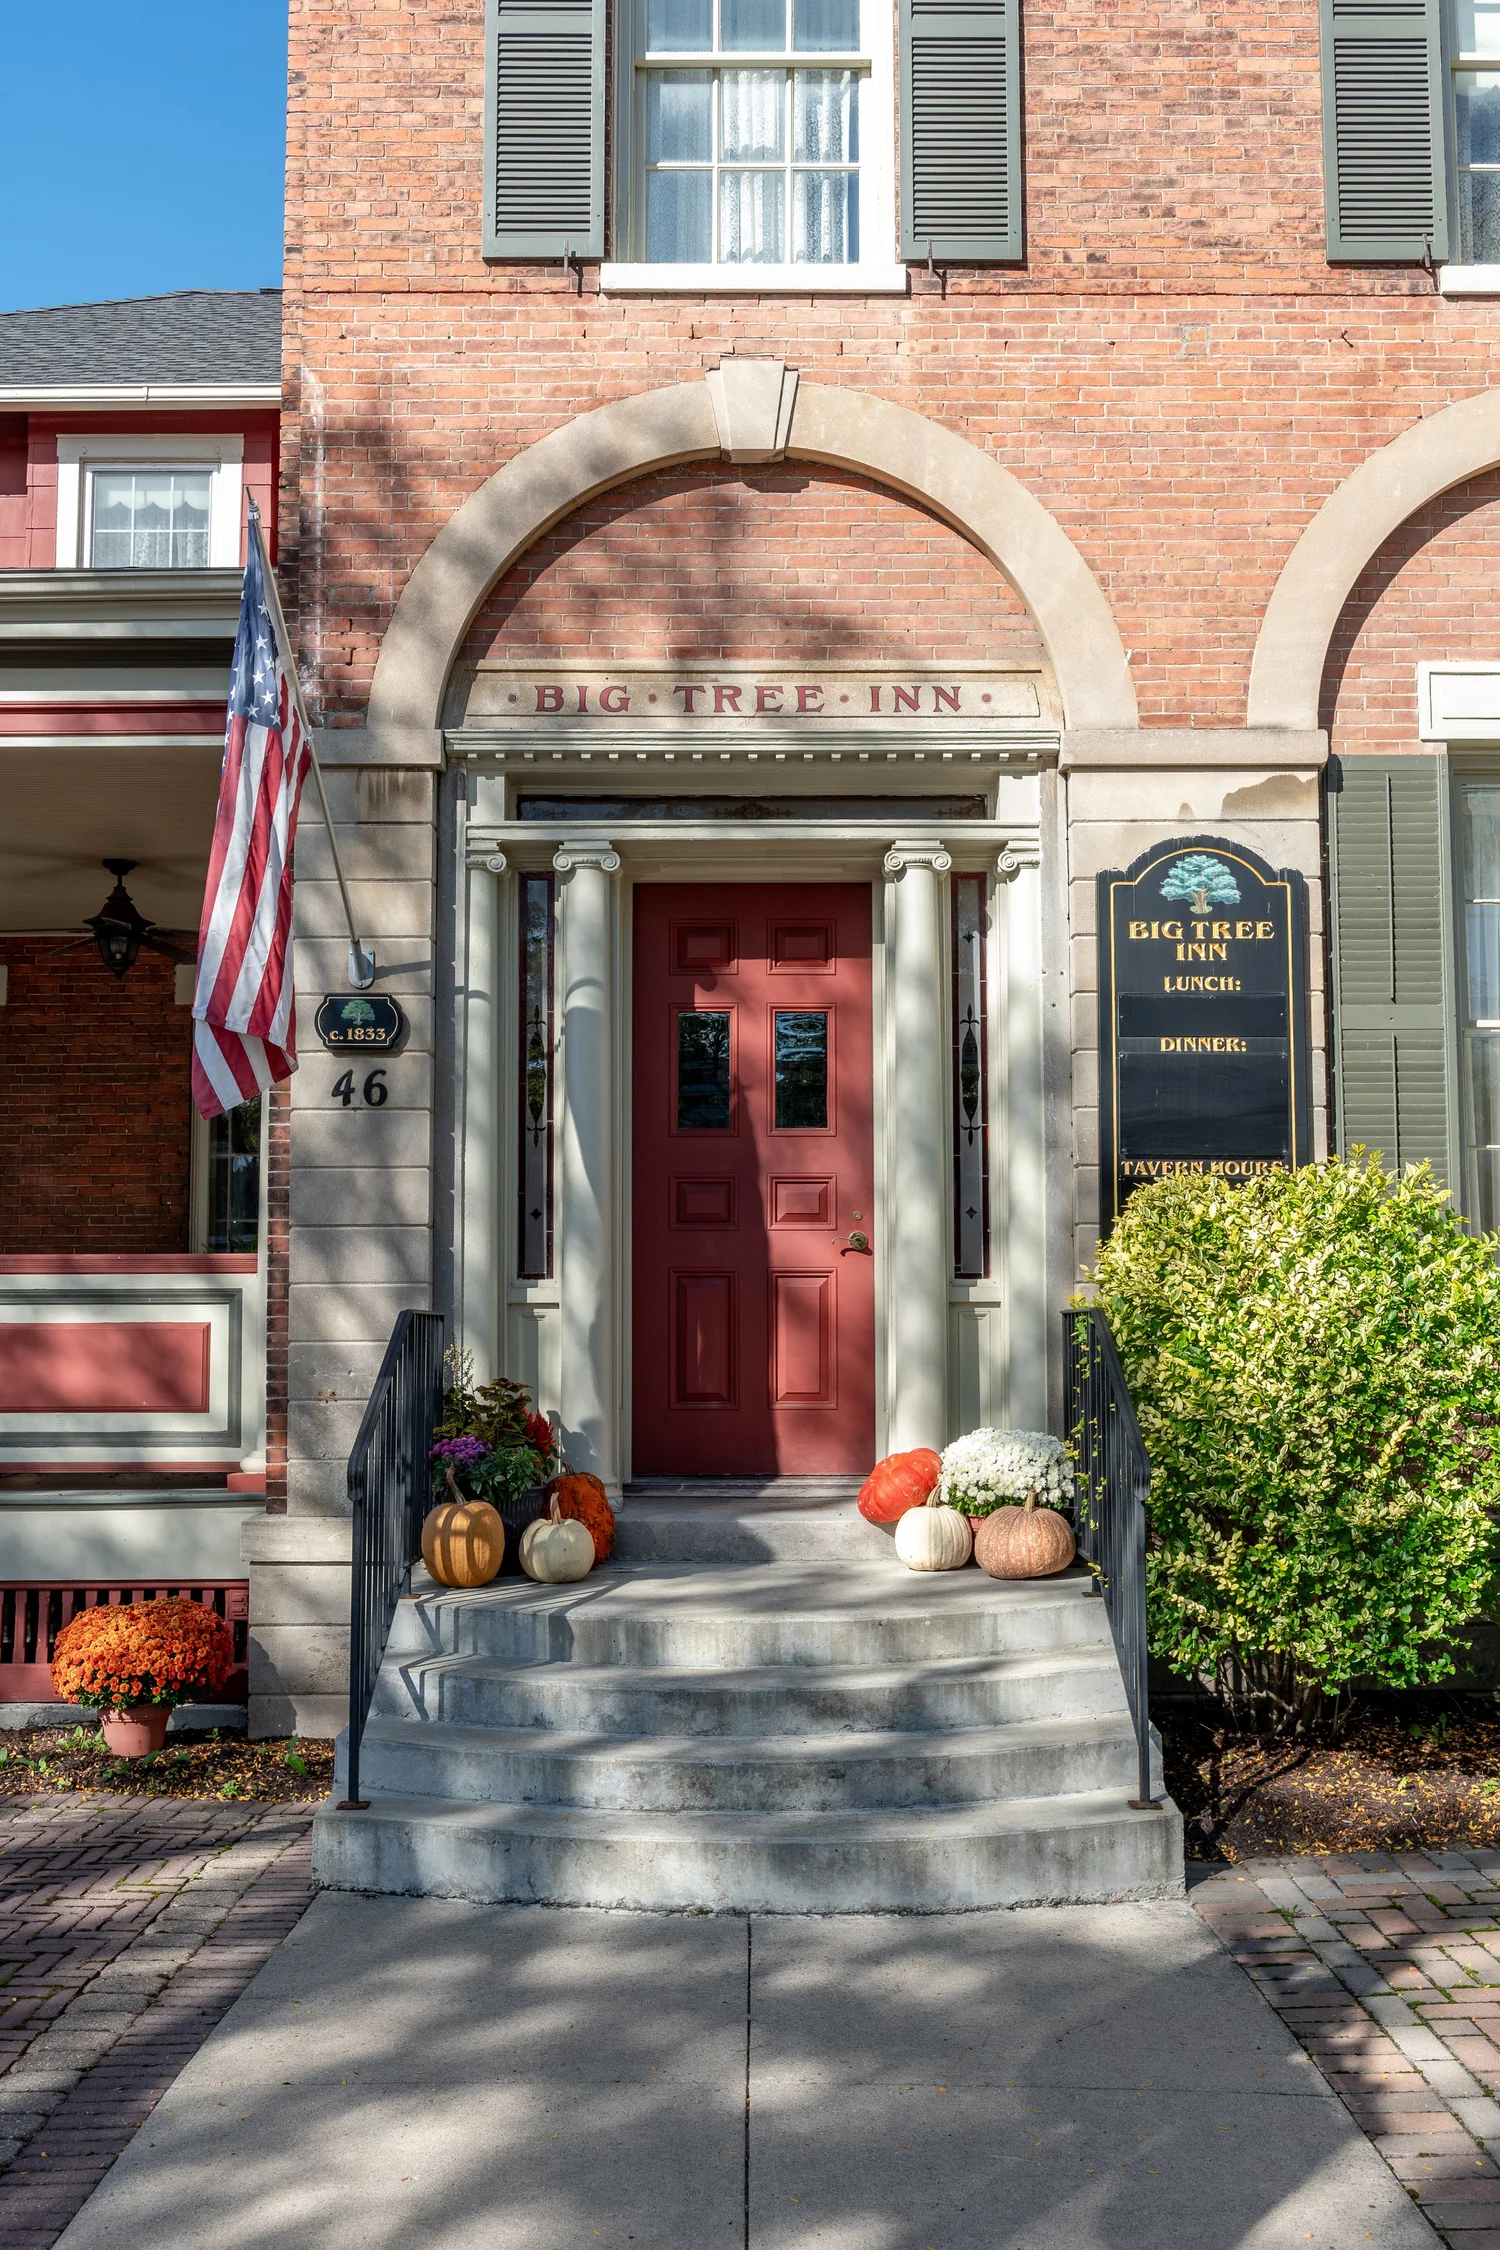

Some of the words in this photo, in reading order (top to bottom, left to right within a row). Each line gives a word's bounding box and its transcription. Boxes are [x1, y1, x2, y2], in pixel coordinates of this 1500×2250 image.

[533, 685, 630, 713] BIG
[673, 685, 826, 713] TREE
[869, 685, 963, 713] INN
[1128, 920, 1184, 940] BIG
[1190, 920, 1275, 940] TREE
[1176, 942, 1228, 961] INN
[1163, 975, 1242, 992] LUNCH:
[329, 1030, 344, 1041] c.
[346, 1027, 386, 1041] 1833
[1159, 1036, 1247, 1052] DINNER:
[331, 1068, 389, 1107] 46
[1120, 1160, 1204, 1176] TAVERN
